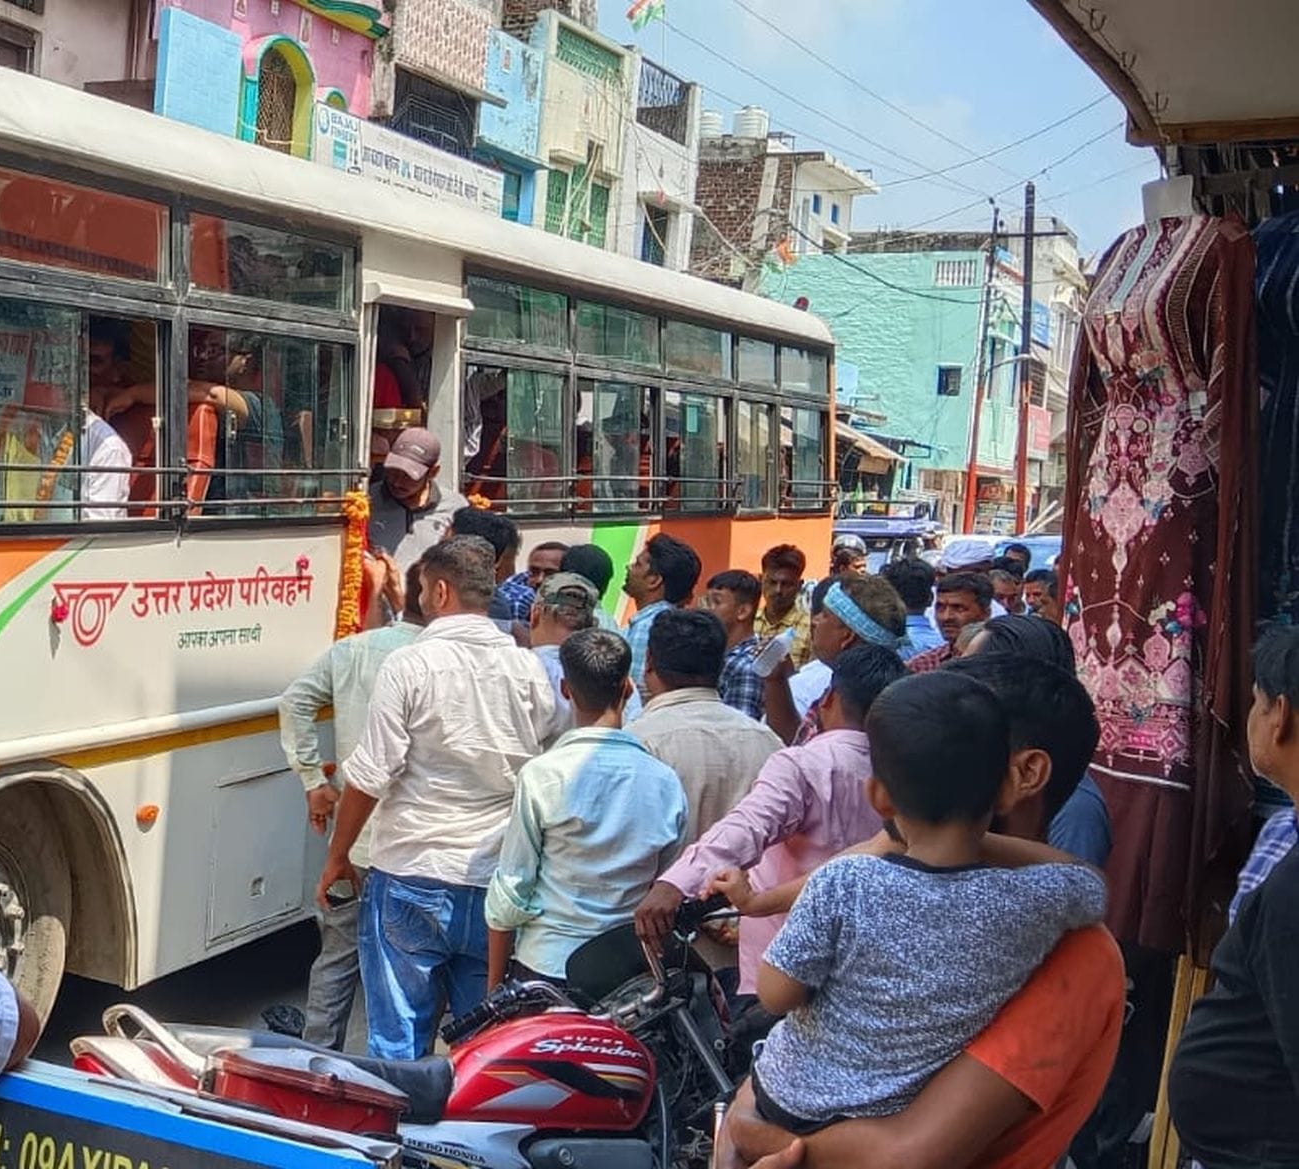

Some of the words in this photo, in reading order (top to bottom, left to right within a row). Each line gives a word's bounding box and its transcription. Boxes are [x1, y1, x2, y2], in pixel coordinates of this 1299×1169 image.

[131, 580, 186, 618] उत्तर
[187, 571, 236, 612] प्रदेश
[237, 565, 314, 608] परिवहन
[208, 628, 237, 648] अपना
[239, 622, 262, 644] साथी
[530, 1038, 644, 1060] Splendor
